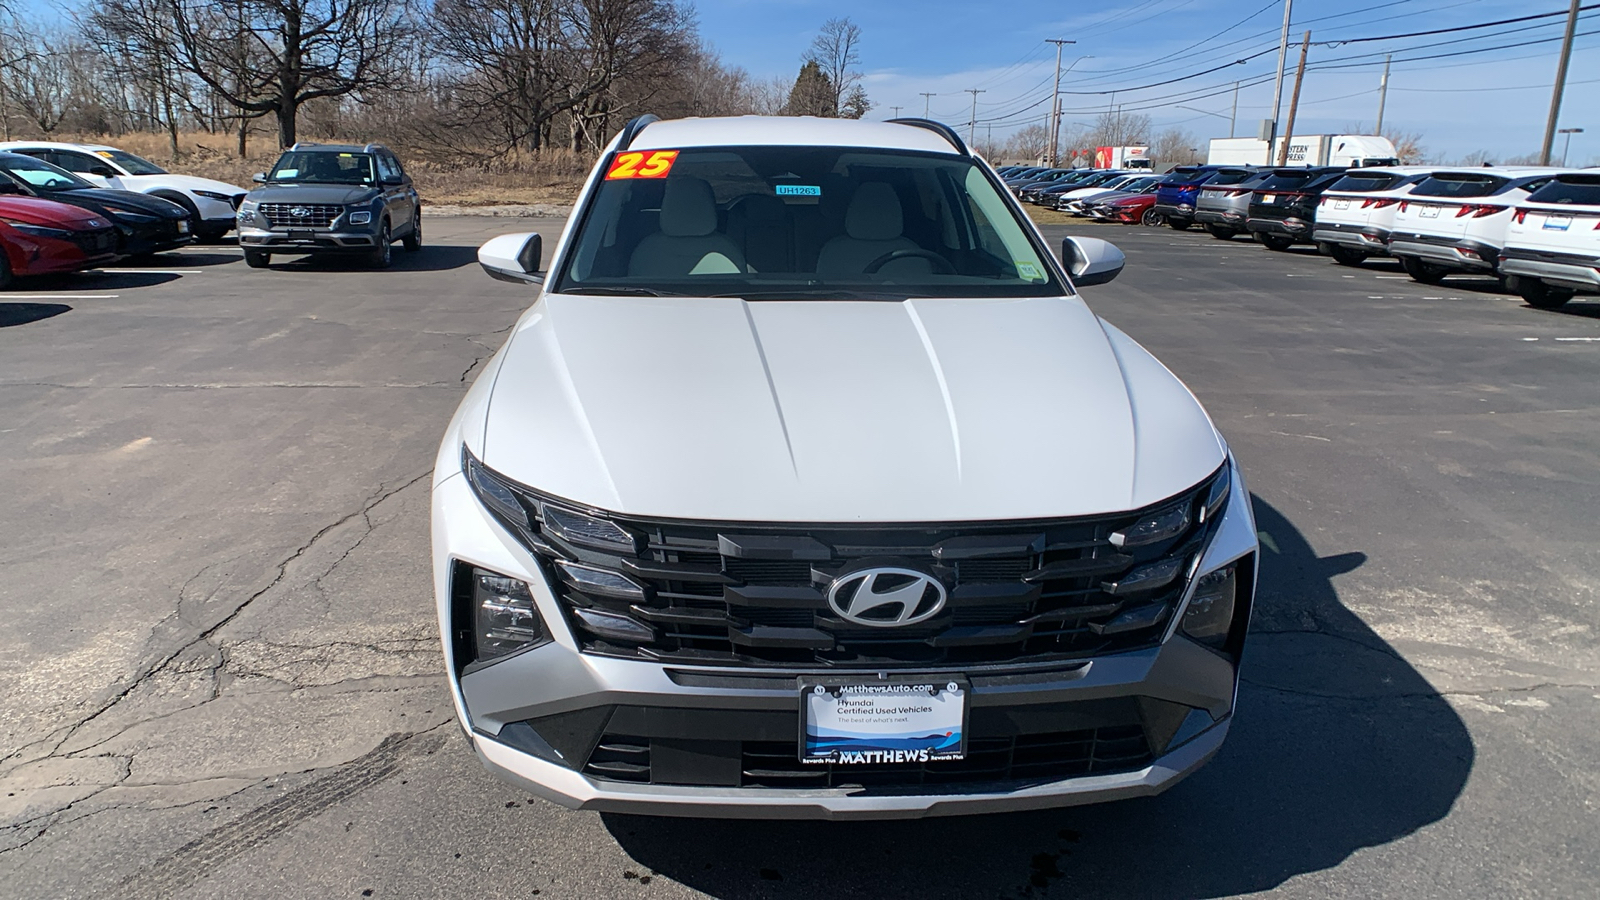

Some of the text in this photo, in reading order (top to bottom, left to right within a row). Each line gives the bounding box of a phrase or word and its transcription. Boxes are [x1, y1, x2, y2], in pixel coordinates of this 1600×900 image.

[608, 151, 676, 178] 25
[839, 684, 933, 694] MatthewsAuto.com
[837, 699, 874, 708] Hyundai
[837, 705, 933, 715] Certified Used Vehicles
[839, 749, 929, 765] MATTHEWS
